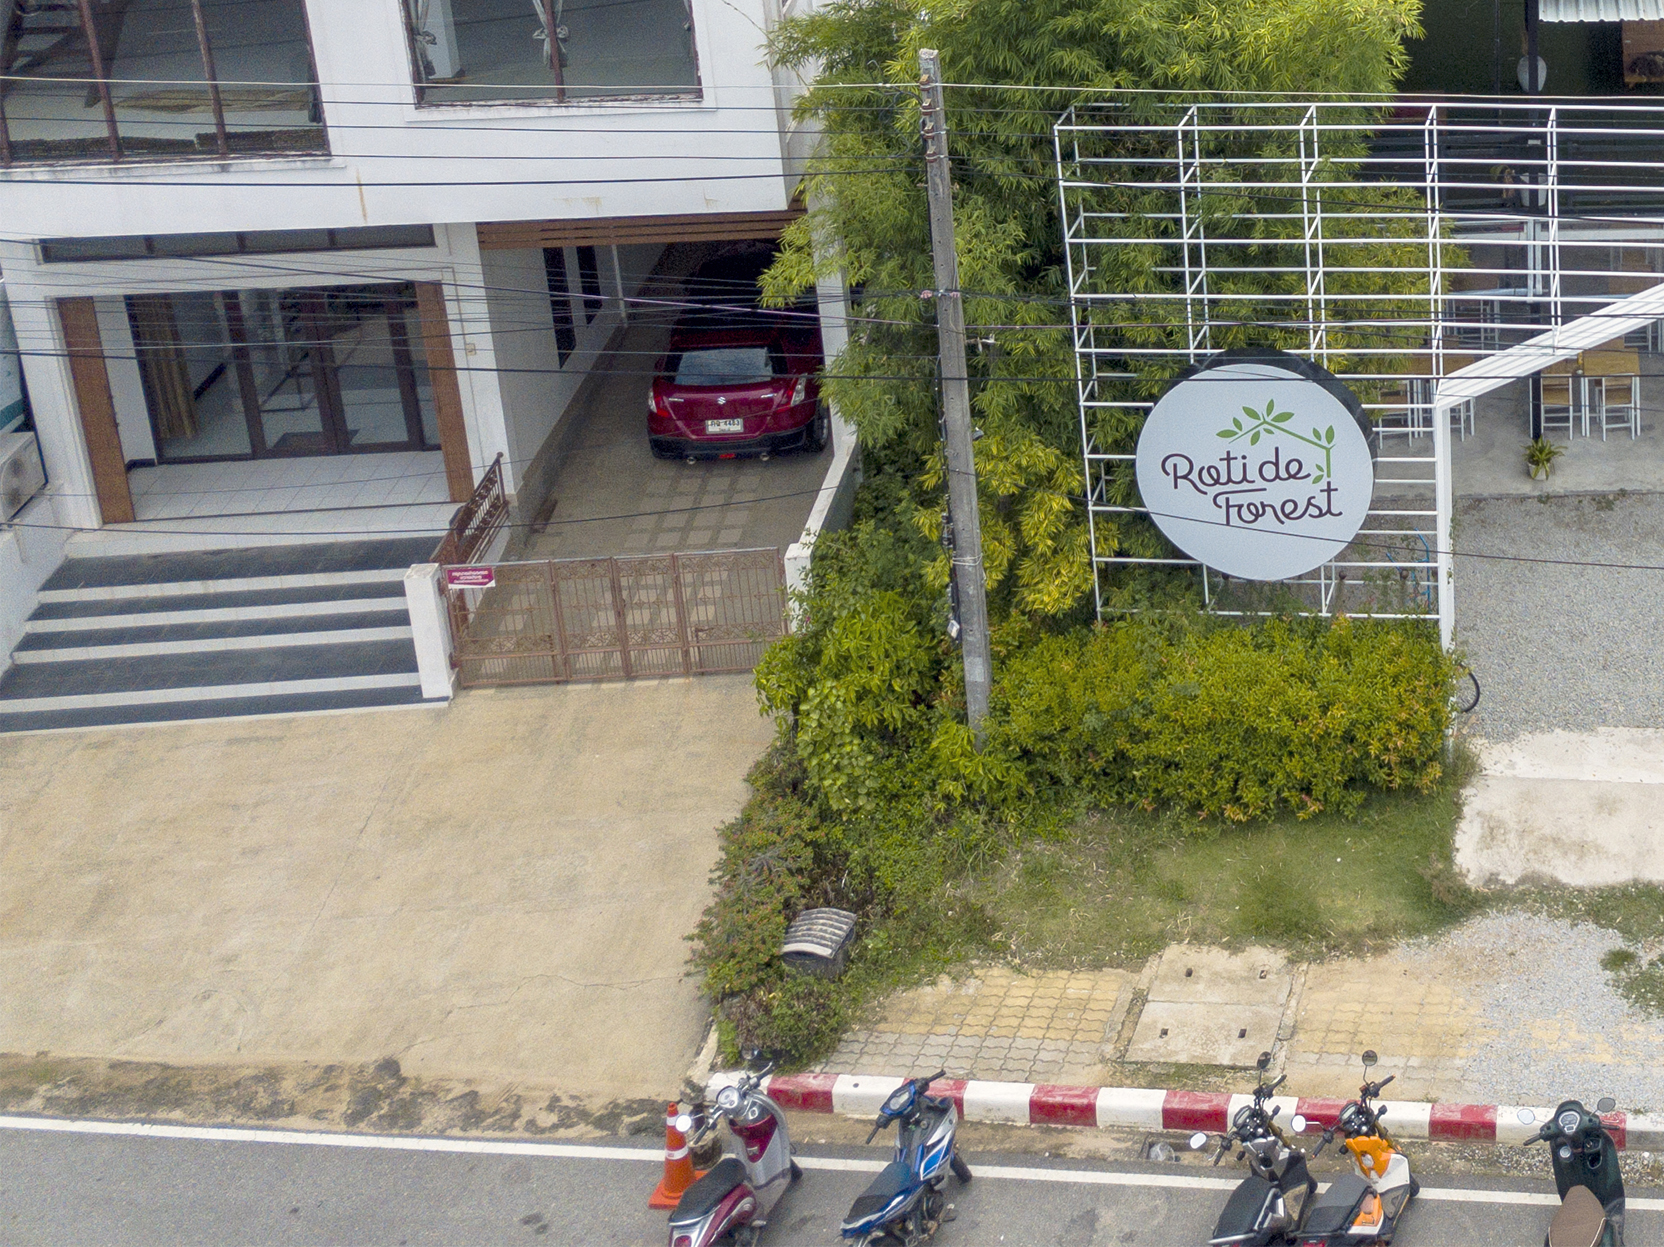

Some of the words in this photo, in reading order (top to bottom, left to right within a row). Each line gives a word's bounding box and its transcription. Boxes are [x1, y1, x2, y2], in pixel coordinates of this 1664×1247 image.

[1161, 450, 1256, 496] Roti
[1258, 446, 1312, 483] de
[1212, 481, 1343, 526] Forest
